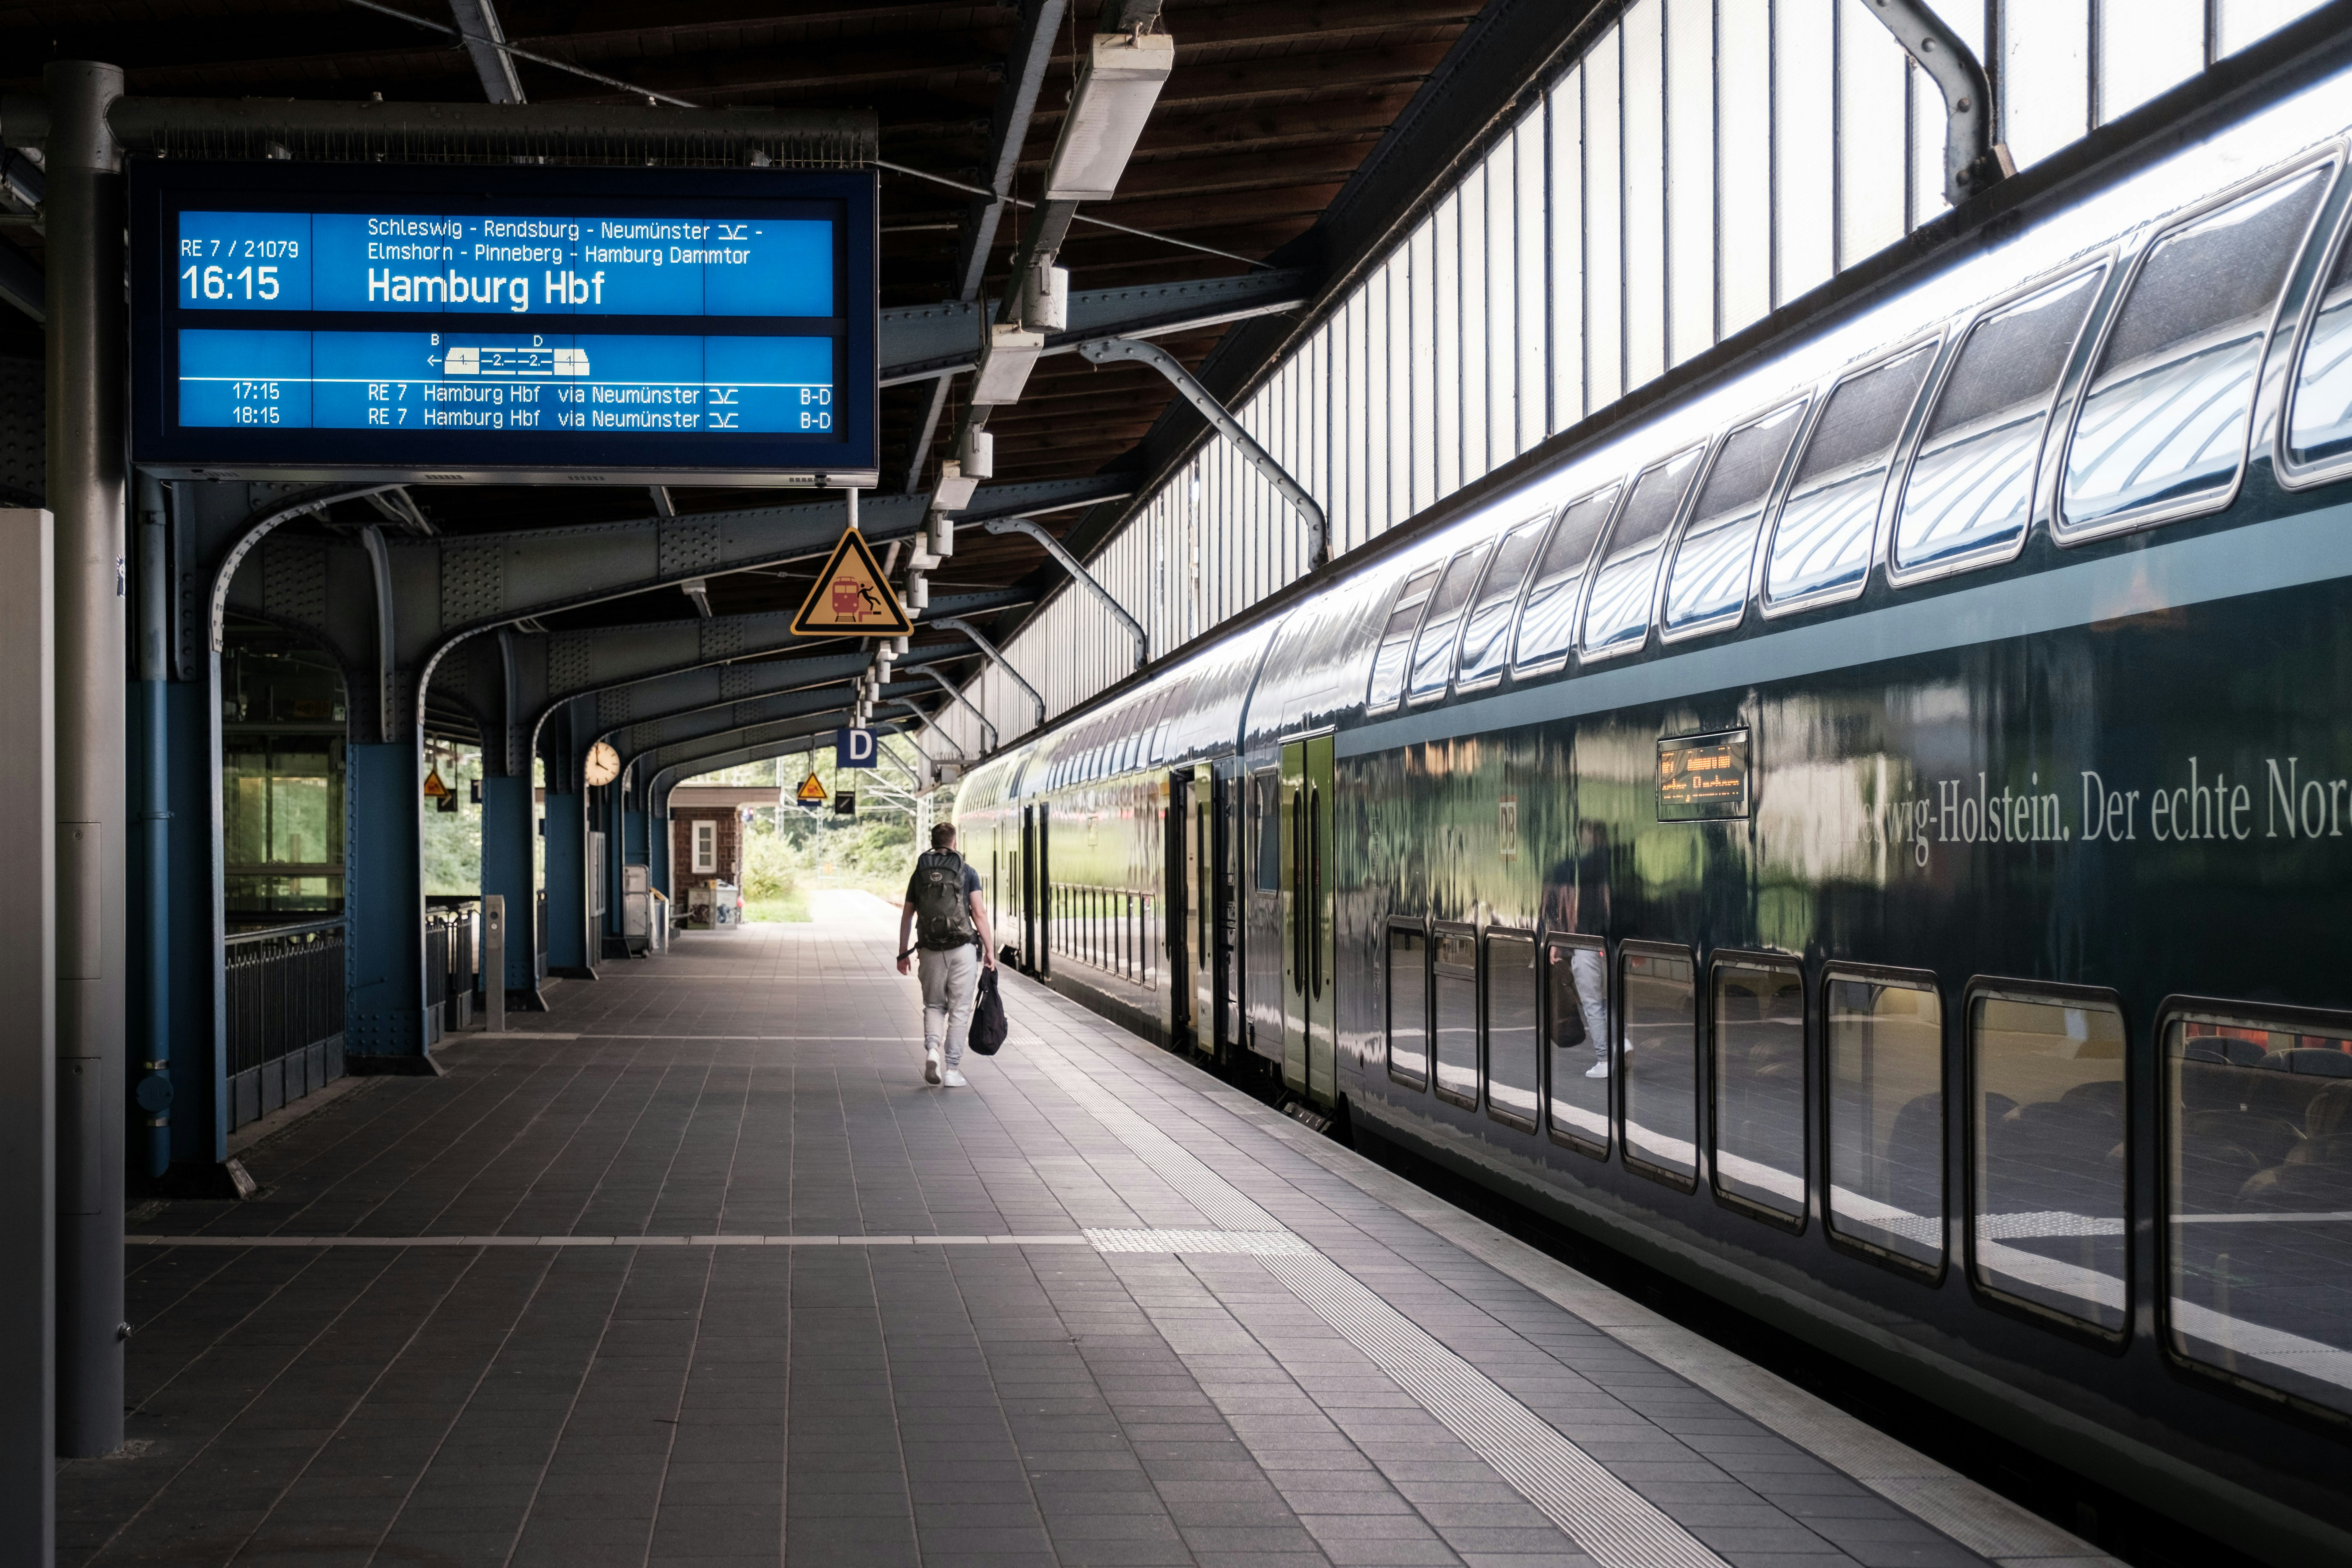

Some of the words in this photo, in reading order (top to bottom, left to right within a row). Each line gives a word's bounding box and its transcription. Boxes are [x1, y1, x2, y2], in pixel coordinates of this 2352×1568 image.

[369, 218, 462, 239] Schleswig
[485, 221, 579, 241] Rendsburg
[602, 222, 710, 240] Neumünster
[182, 240, 202, 257] RE
[211, 240, 220, 257] 7
[228, 240, 236, 257] /
[245, 241, 298, 258] 21079
[369, 243, 452, 260] Elmshorn
[476, 244, 562, 264] Pinneberg
[586, 246, 662, 266] Hamburg
[670, 247, 750, 264] Dammtor
[182, 266, 279, 300] 16:15
[369, 268, 529, 312] Hamburg
[546, 271, 605, 304] Hbf
[431, 334, 439, 346] B
[534, 335, 543, 346] D
[233, 382, 280, 400] 17:15
[369, 384, 389, 400] RE
[398, 385, 407, 401] 7
[425, 385, 502, 405] Hamburg
[511, 386, 540, 402] Hbf
[558, 387, 584, 403] via
[593, 387, 700, 403] Neumünster
[801, 388, 830, 405] B-D
[233, 407, 280, 423] 18:15
[369, 408, 389, 424] RE
[398, 408, 407, 425] 7
[425, 409, 502, 429] Hamburg
[511, 410, 540, 426] Hbf
[558, 411, 584, 426] via
[593, 411, 700, 427] Neumünster
[801, 412, 830, 429] B-D
[850, 730, 872, 760] D
[2081, 771, 2139, 842] Der
[2152, 756, 2251, 841] echte
[2266, 757, 2352, 839] Nor
[1501, 807, 1514, 850] DB
